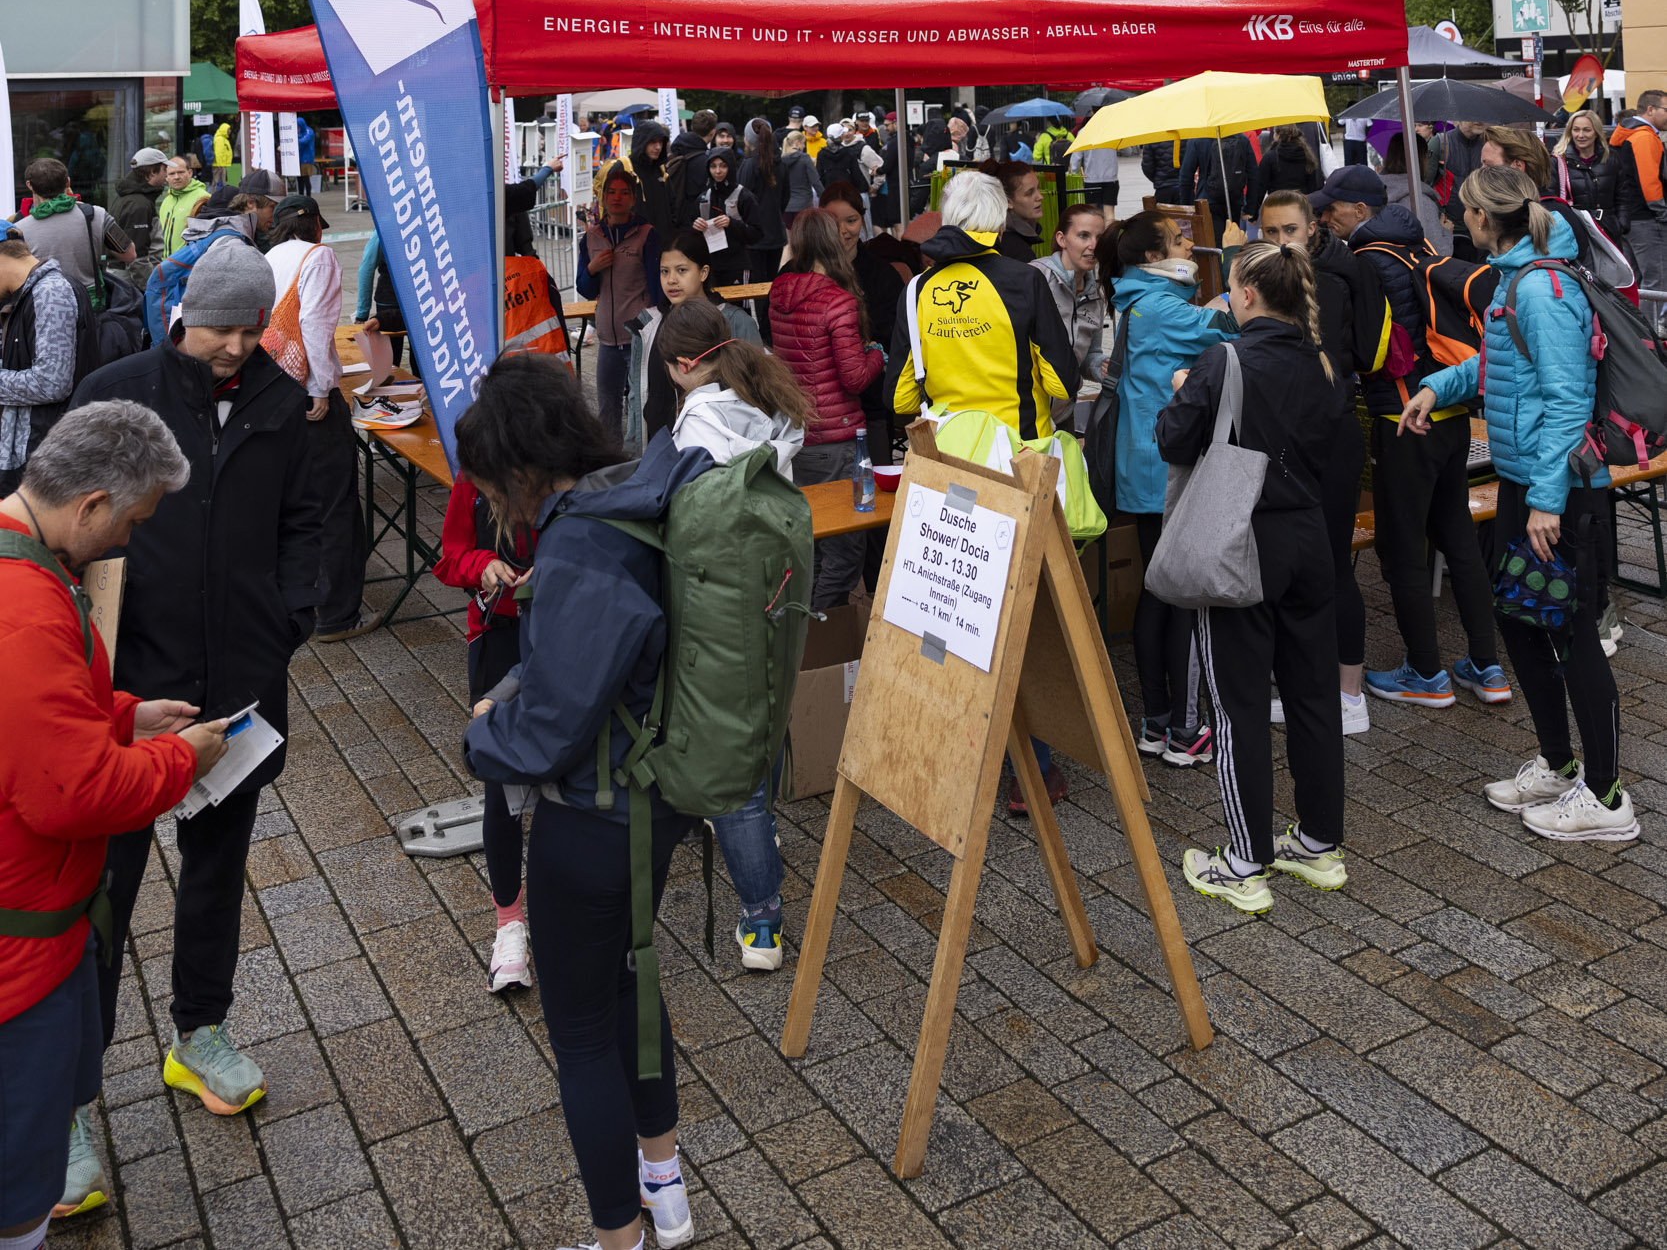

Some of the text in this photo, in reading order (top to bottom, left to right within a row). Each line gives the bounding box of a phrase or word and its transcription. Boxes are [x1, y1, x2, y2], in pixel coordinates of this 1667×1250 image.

[544, 17, 1157, 44] ENERGIE INTERNET UND IT WASSER UND ABWASSER ABFALL BÄDER
[1298, 21, 1324, 34] Eins
[1326, 21, 1342, 34] für
[1344, 19, 1366, 32] alle.
[1347, 58, 1386, 68] MASTERTENT
[927, 321, 992, 338] Laufverein
[937, 315, 979, 325] Südtiroler
[940, 507, 977, 533] Dusche
[919, 522, 990, 562] Shower/ Docia
[922, 546, 943, 566] 8.30
[952, 558, 978, 581] 13.30
[902, 558, 992, 609] HTL Anichstraße (Zugang
[929, 587, 958, 611] Innrain)
[920, 601, 930, 614] ca.
[938, 607, 953, 623] km/
[955, 616, 964, 629] 14
[965, 620, 981, 638] min.
